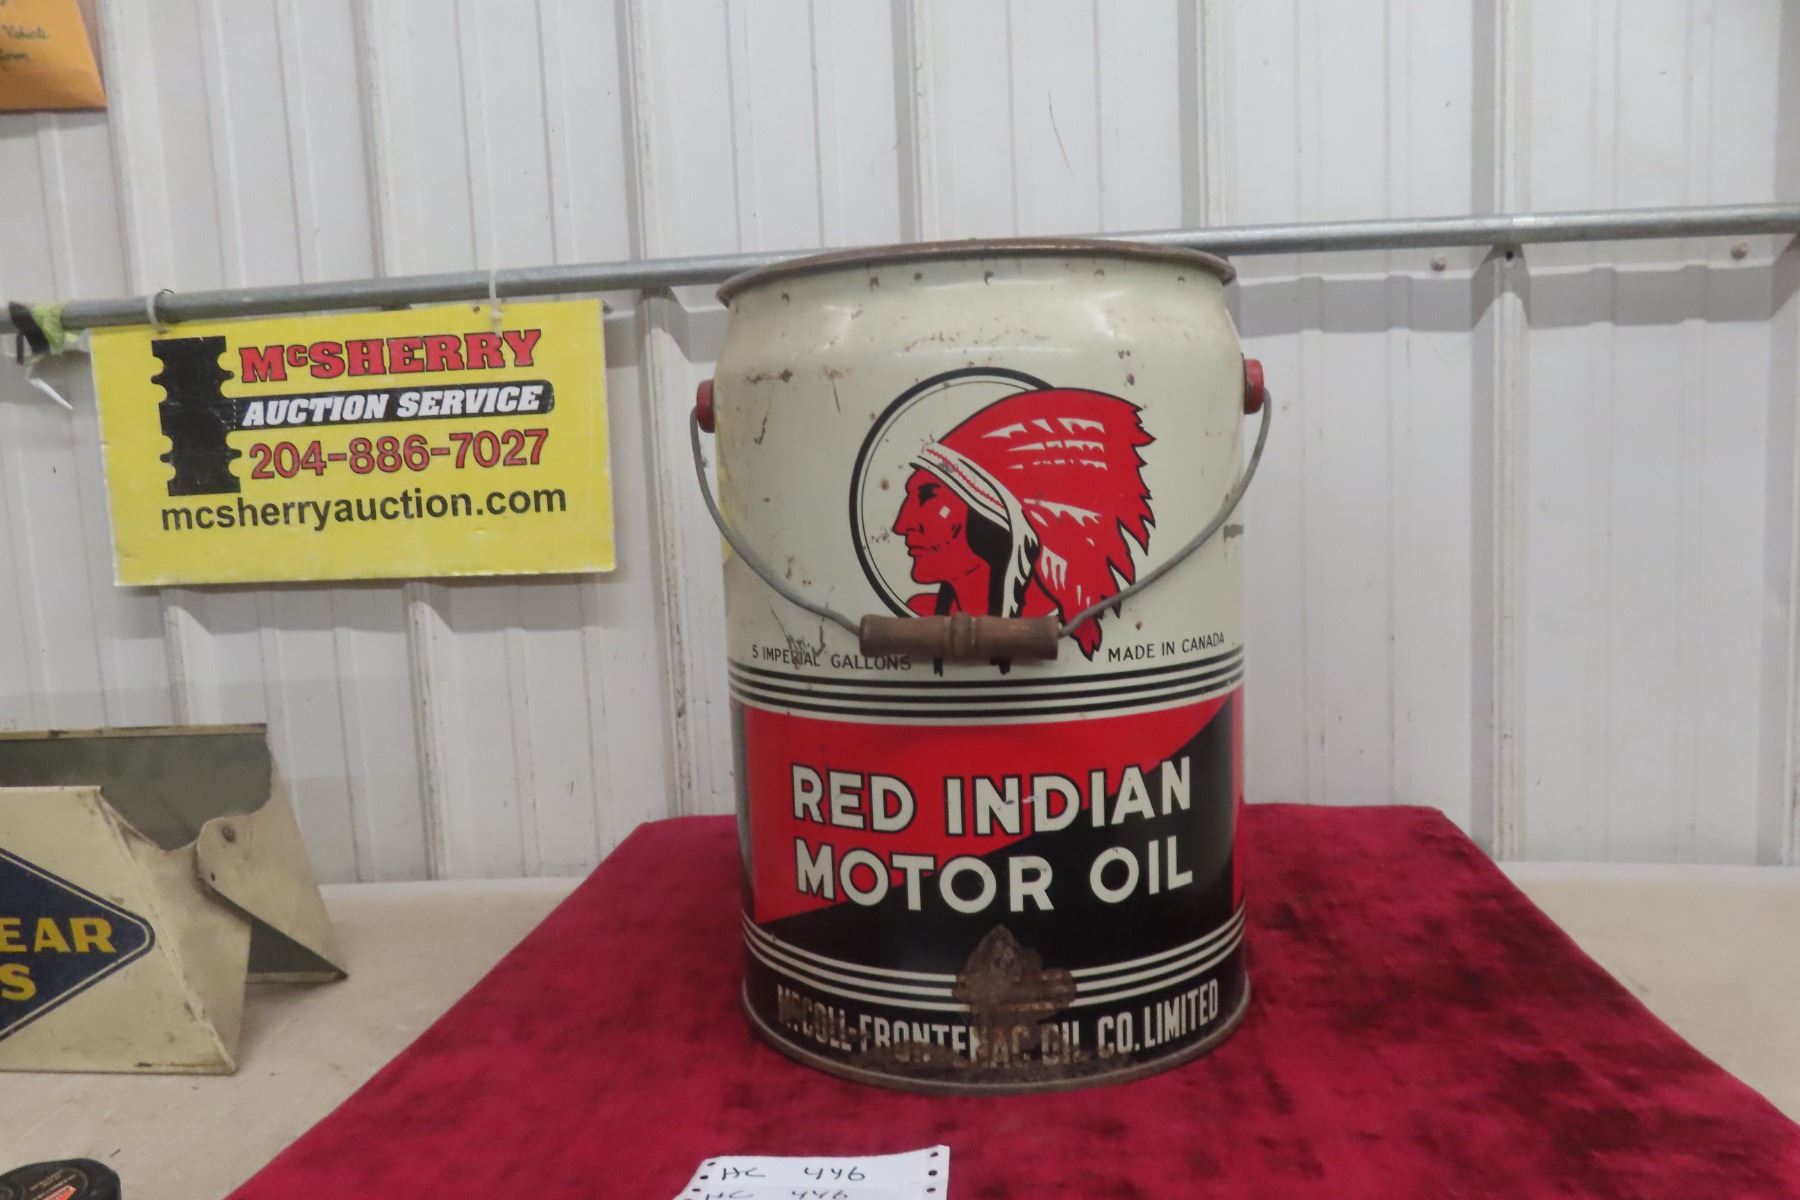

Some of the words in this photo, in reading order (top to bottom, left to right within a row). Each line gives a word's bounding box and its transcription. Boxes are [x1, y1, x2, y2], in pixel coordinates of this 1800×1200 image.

[239, 329, 542, 383] McSHERRY
[242, 395, 389, 428] AUCTION
[396, 385, 543, 418] SERVICE
[249, 429, 550, 480] 204-886-7027
[161, 488, 567, 531] mcsherryauction.com
[751, 643, 760, 659] 5
[763, 647, 822, 668] IMPERIAL
[830, 653, 913, 672] GALLONS
[1107, 643, 1155, 663] MADE
[1161, 641, 1178, 657] IN
[1181, 631, 1226, 654] CANADA
[791, 763, 916, 835] RED
[945, 756, 1193, 836] INDIAN
[795, 837, 1055, 914] MOTOR
[1088, 835, 1194, 904] OIL
[1143, 979, 1219, 1048] LIMITED
